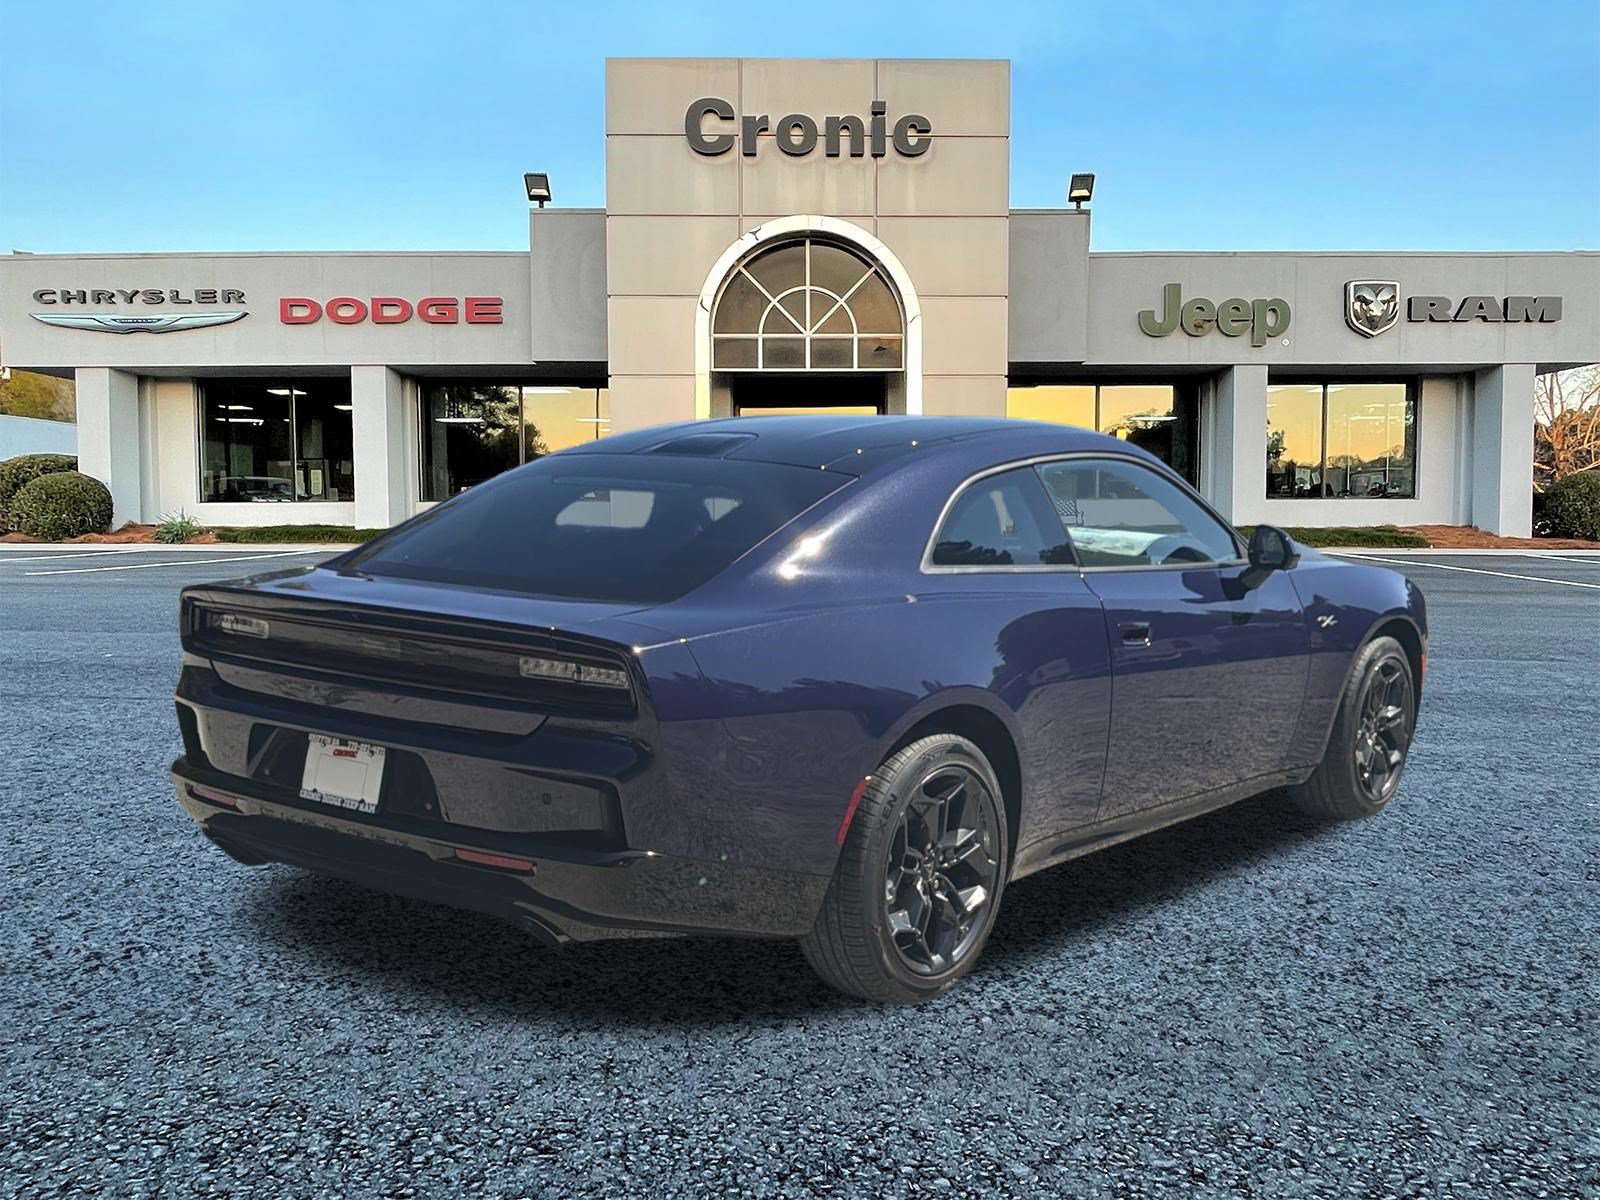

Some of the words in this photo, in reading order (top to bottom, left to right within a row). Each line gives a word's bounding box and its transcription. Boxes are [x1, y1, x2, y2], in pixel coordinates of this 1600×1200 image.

[685, 97, 932, 158] Cronic
[33, 288, 247, 304] CHRYSLER
[1407, 296, 1562, 323] RAM
[280, 297, 503, 324] DODGE
[1138, 283, 1292, 347] Jeep
